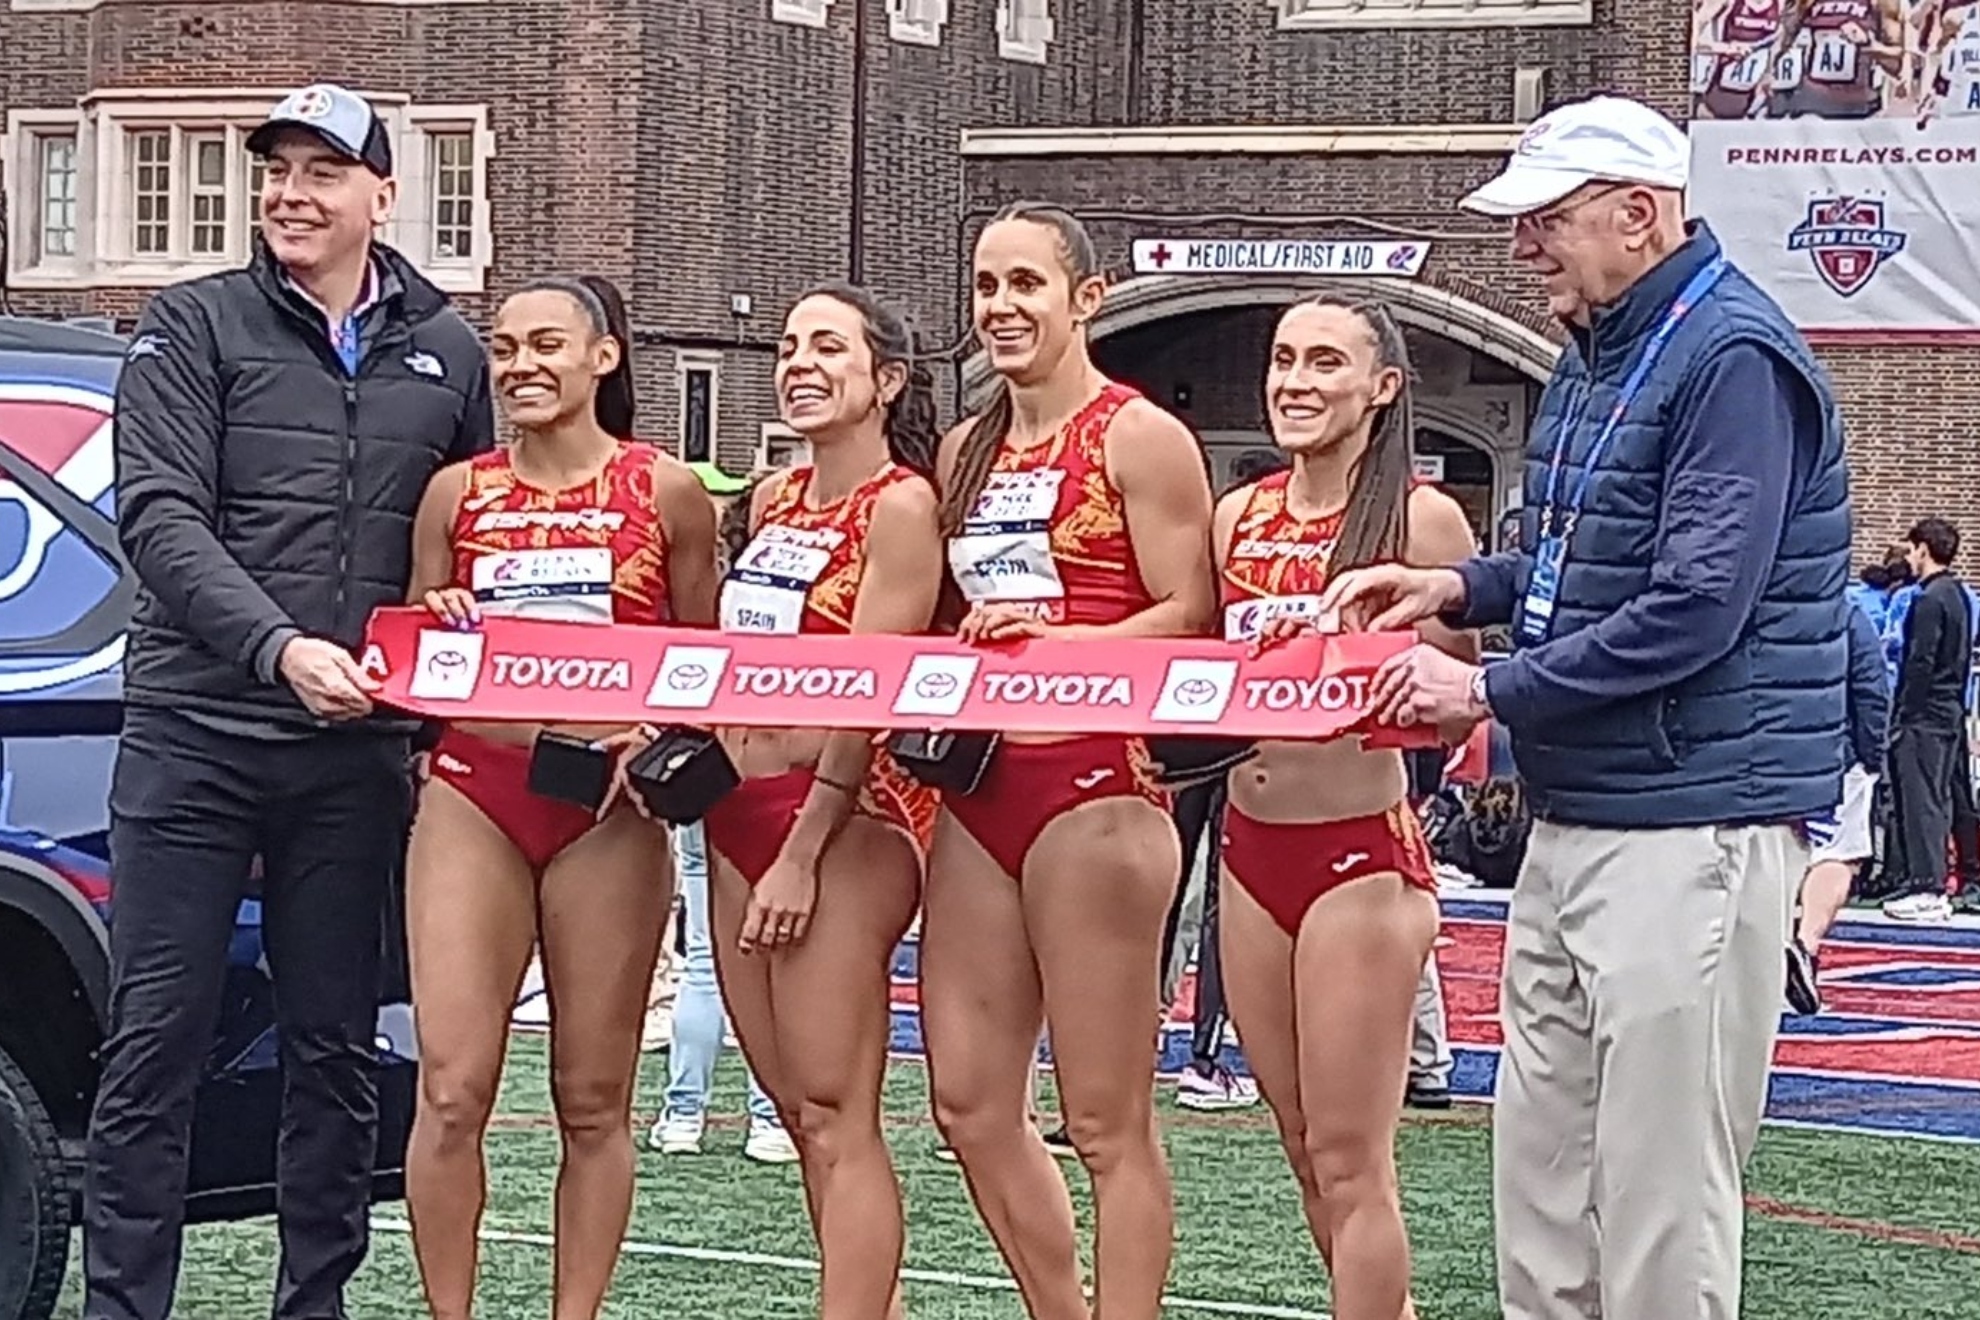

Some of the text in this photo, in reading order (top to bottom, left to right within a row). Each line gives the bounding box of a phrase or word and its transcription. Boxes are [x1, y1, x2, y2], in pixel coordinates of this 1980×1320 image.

[1819, 43, 1846, 72] AJ
[1726, 147, 1977, 164] PENNRELAYS.COM
[1187, 244, 1374, 270] MEDICAL/FIRST AID
[491, 654, 631, 690] TOYOTA
[733, 665, 877, 699] TOYOTA
[982, 672, 1133, 707] TOYOTA
[1245, 675, 1376, 711] TOYOT
